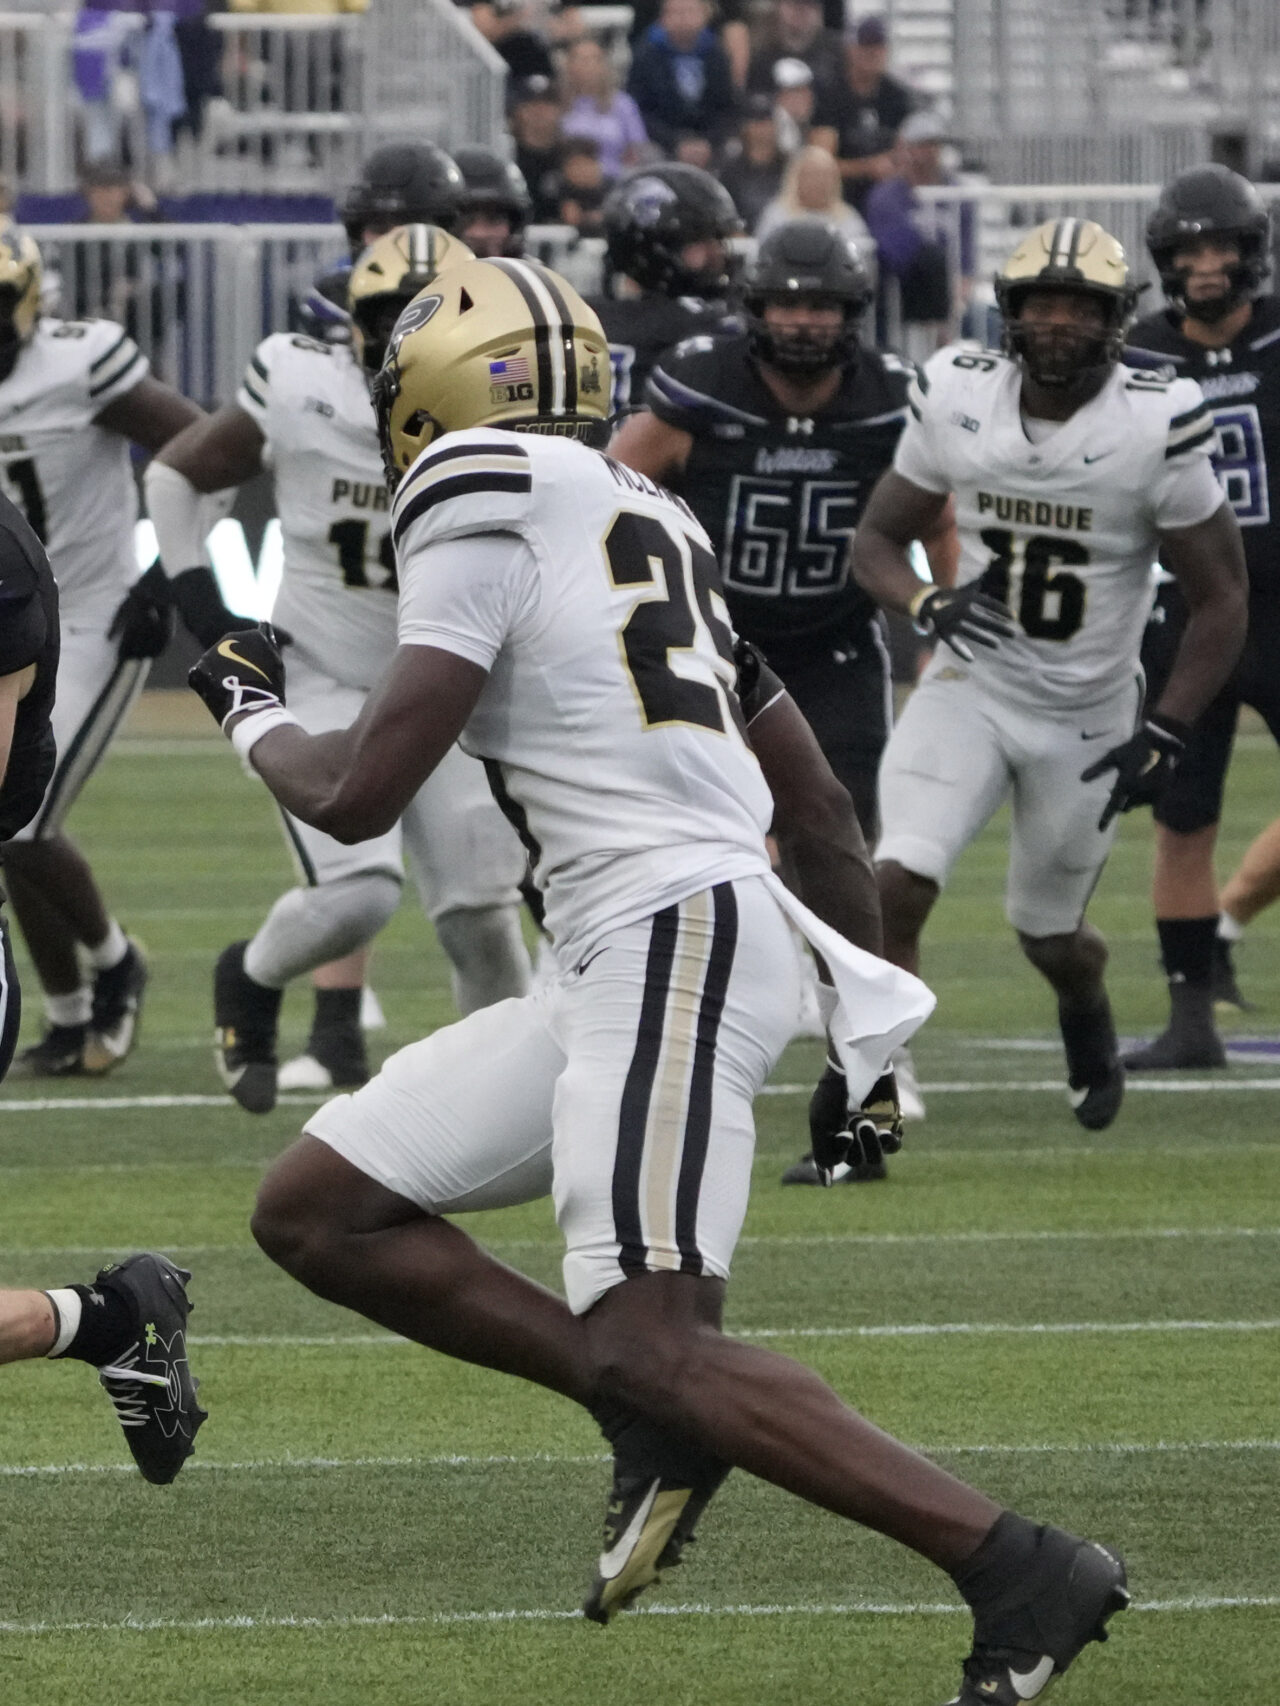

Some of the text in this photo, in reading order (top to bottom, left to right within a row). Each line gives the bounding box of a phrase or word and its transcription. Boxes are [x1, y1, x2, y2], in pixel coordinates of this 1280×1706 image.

[332, 478, 391, 511] PUR
[977, 490, 1094, 531] PURDUE
[723, 474, 861, 597] 65
[980, 528, 1091, 643] 16
